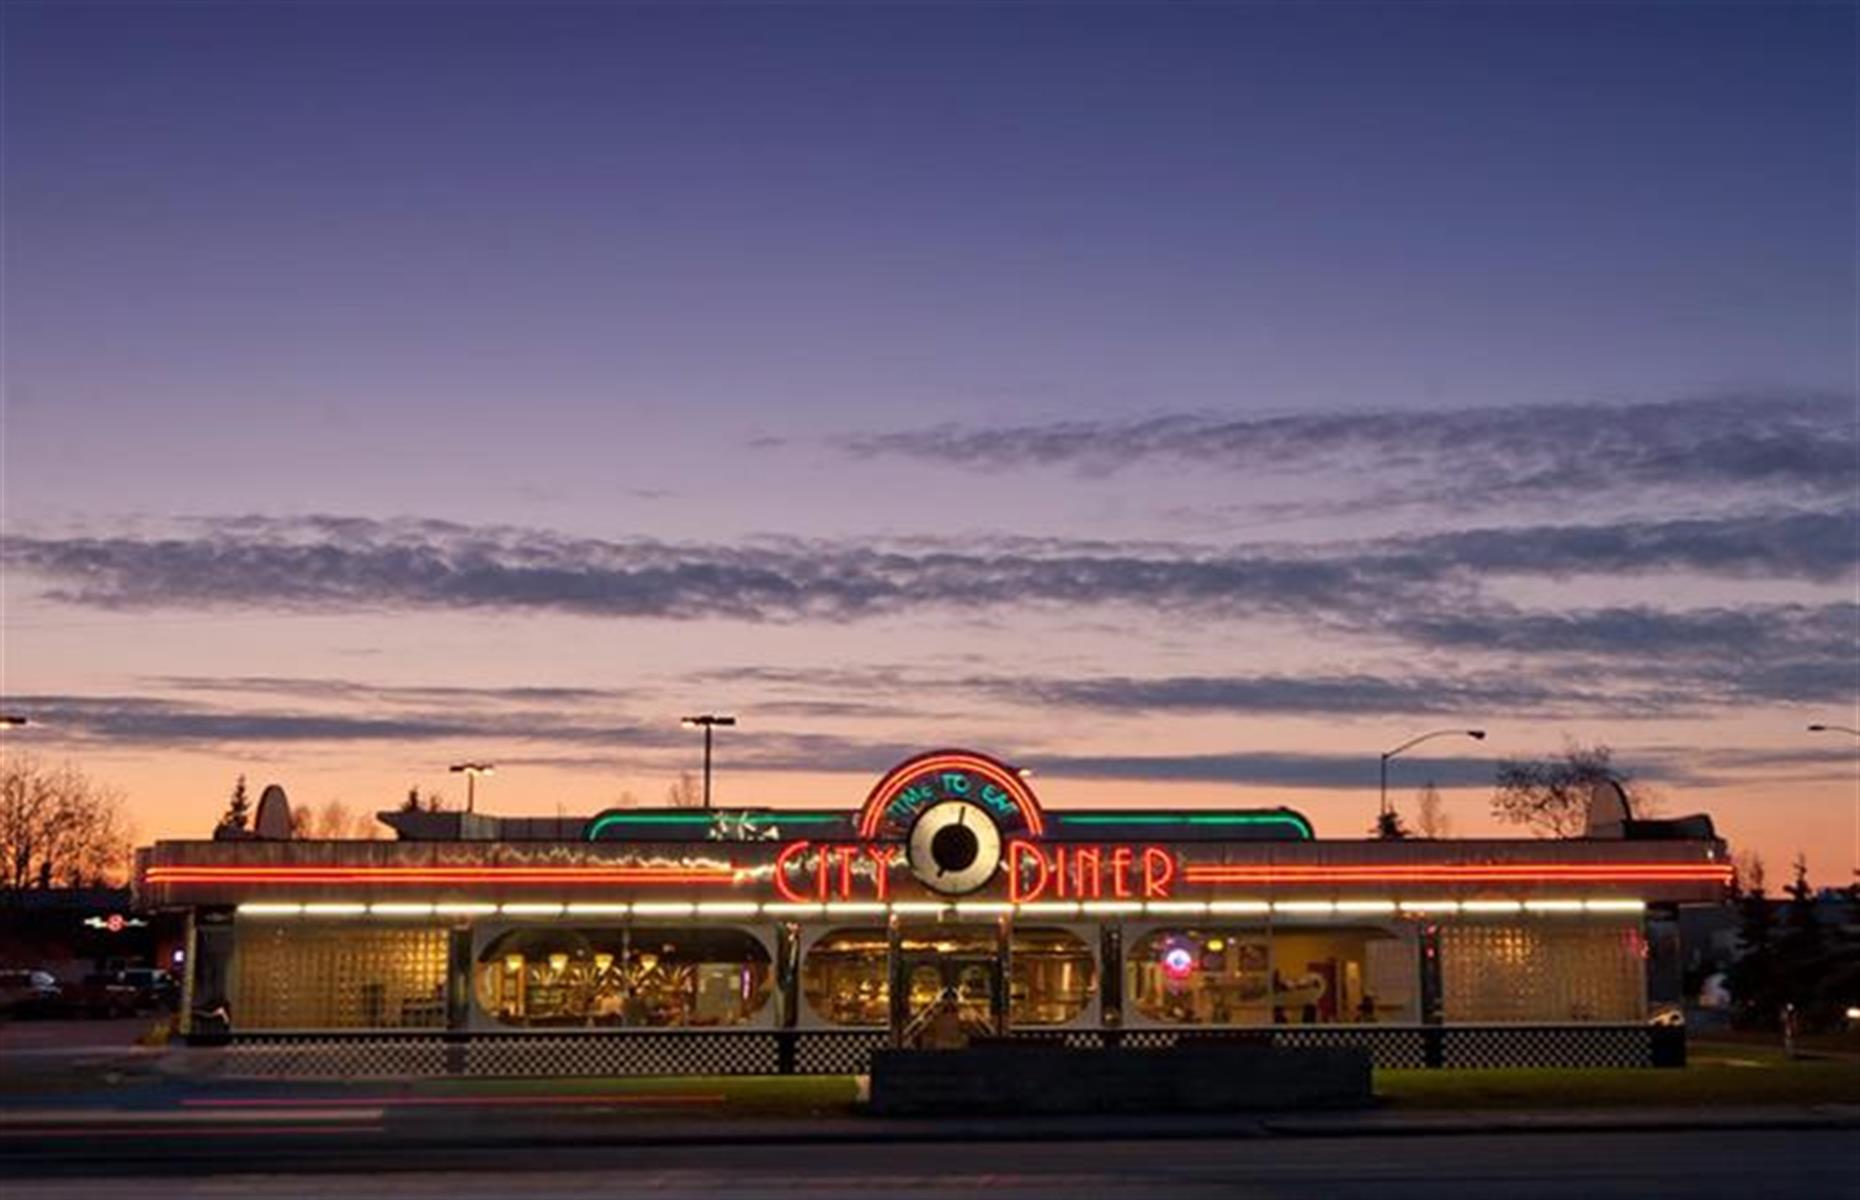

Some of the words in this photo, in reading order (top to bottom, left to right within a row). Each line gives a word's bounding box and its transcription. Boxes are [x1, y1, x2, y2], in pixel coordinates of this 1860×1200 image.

[942, 773, 970, 794] TO
[980, 784, 1018, 815] EAT
[775, 840, 896, 903] CITY
[1009, 840, 1173, 903] DINER
